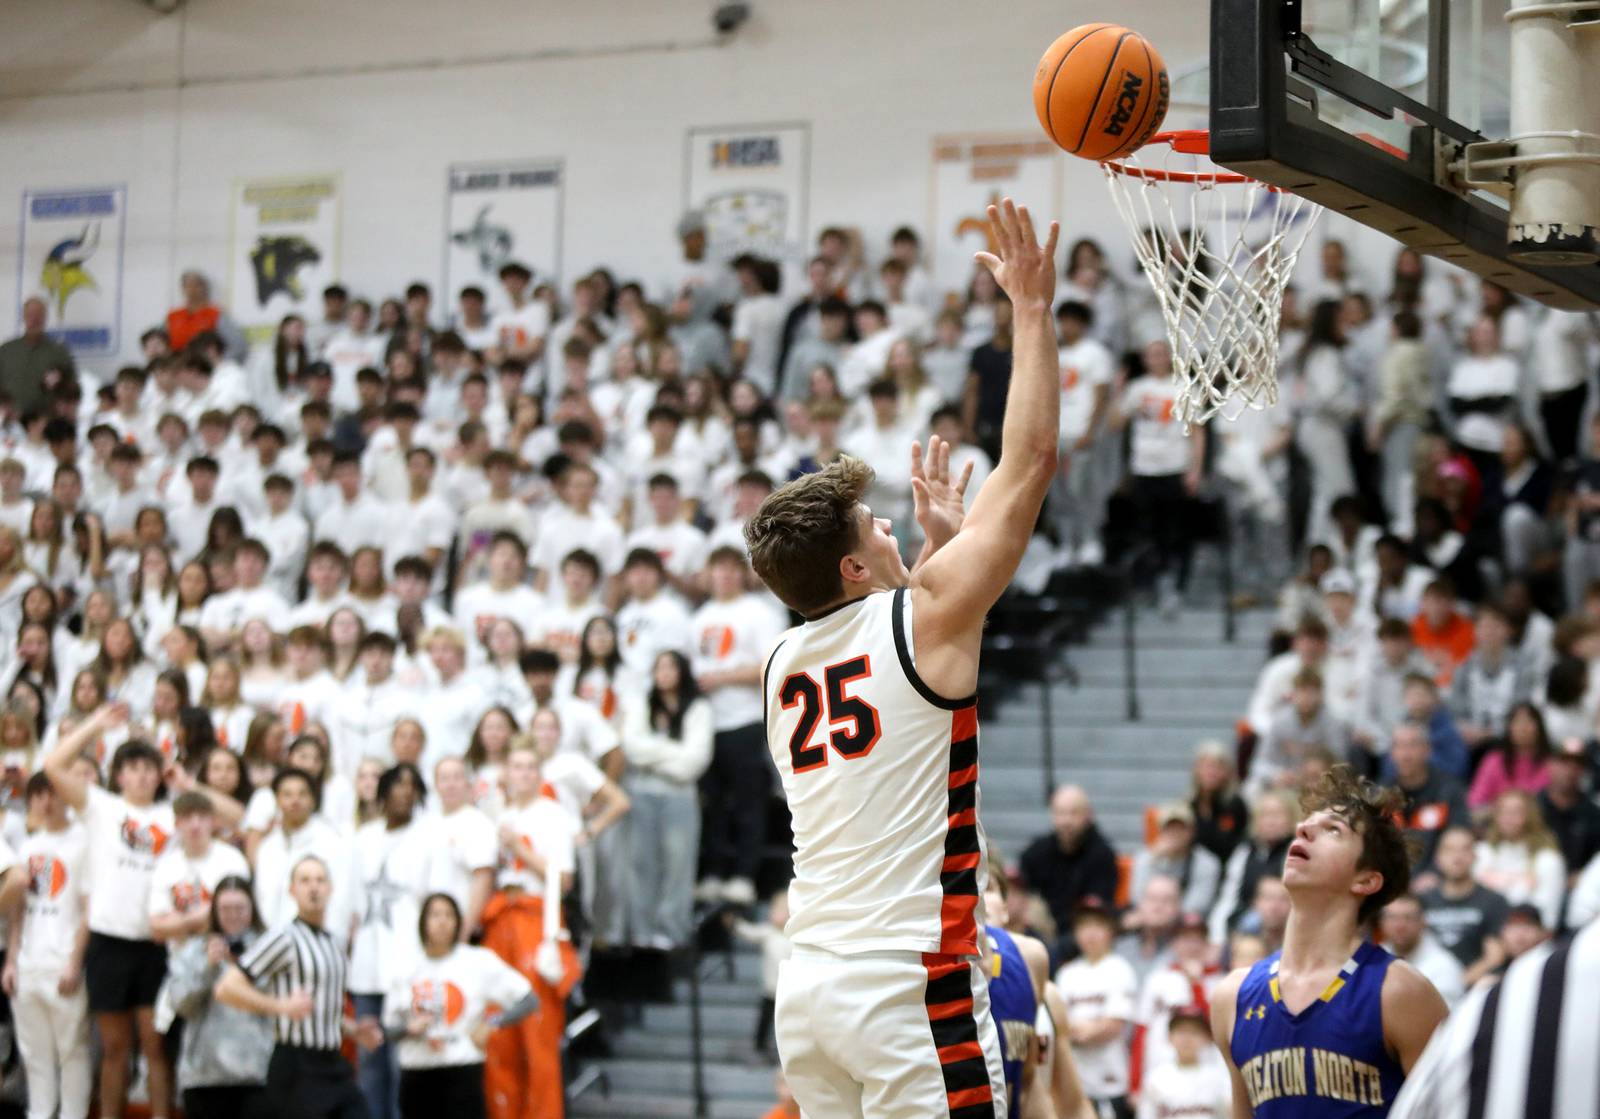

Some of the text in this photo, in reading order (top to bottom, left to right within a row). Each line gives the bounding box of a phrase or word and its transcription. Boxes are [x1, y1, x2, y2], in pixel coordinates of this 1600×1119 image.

[1103, 71, 1143, 136] NCAA
[779, 654, 882, 774] 25
[1312, 1048, 1384, 1106] NORTH
